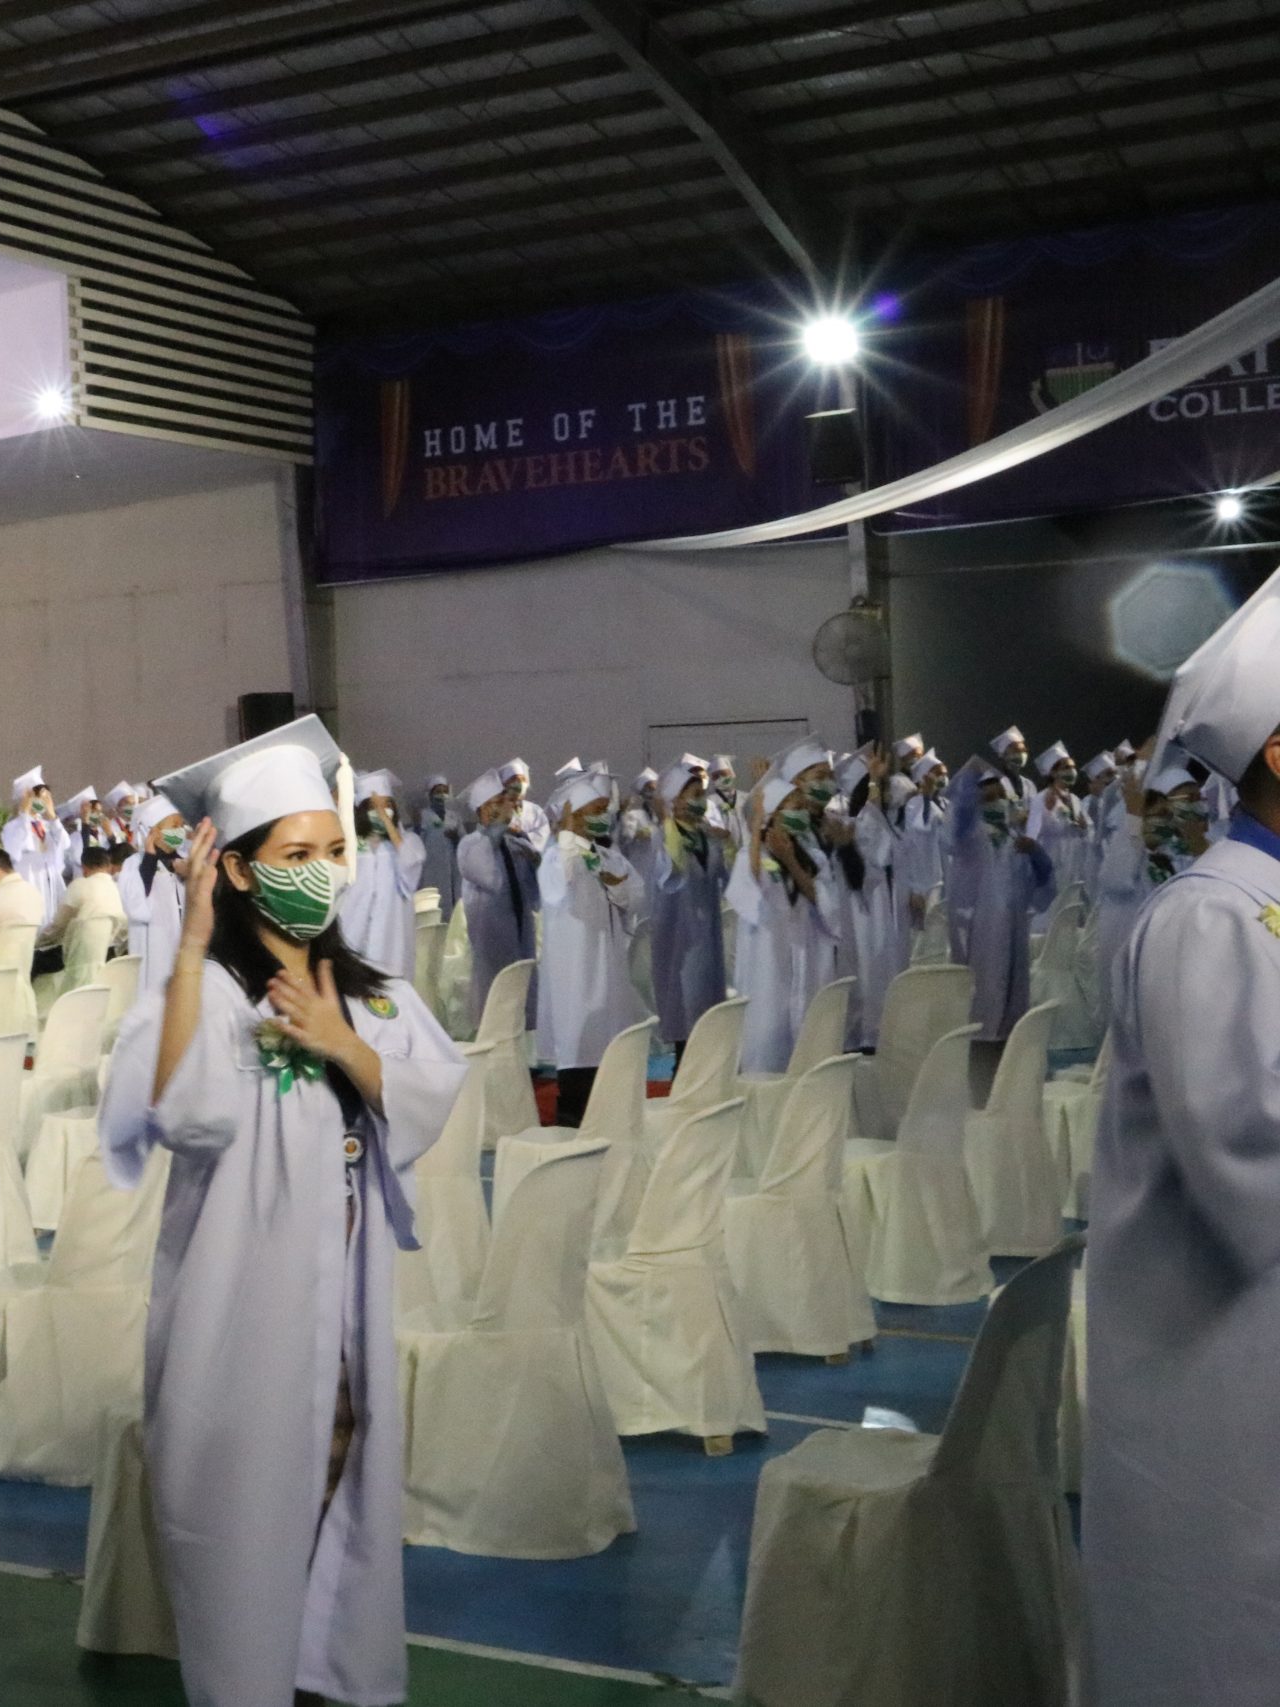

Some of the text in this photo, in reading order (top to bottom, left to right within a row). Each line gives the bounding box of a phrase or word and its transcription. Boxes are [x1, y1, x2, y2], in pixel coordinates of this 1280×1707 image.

[423, 396, 706, 457] HOME OF THE
[424, 438, 710, 500] BRAVEHEARTS
